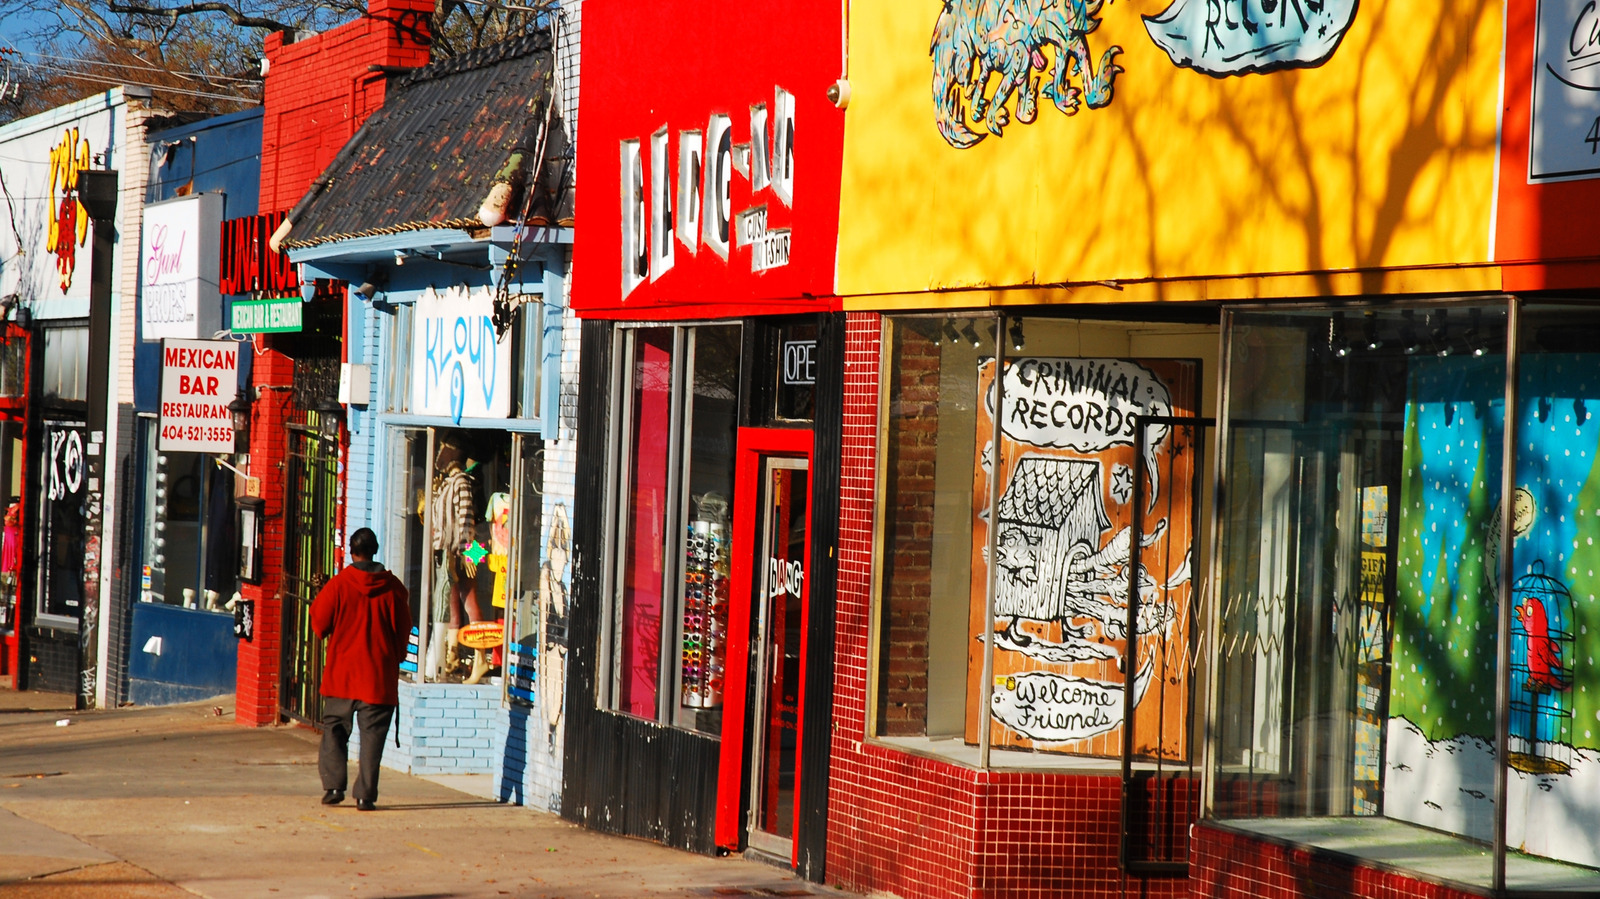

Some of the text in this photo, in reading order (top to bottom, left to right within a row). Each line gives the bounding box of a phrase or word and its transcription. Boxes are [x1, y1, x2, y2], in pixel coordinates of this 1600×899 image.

[747, 210, 768, 240] CUST
[146, 223, 187, 287] Gurl
[219, 215, 260, 296] LUNA
[165, 347, 236, 370] MEXICAN
[425, 315, 497, 411] KLOUD
[786, 344, 816, 380] OPE
[179, 375, 219, 396] BAR
[1011, 397, 1137, 437] RECORDS
[1015, 679, 1117, 707] Welcome
[1014, 703, 1113, 730] Friends
